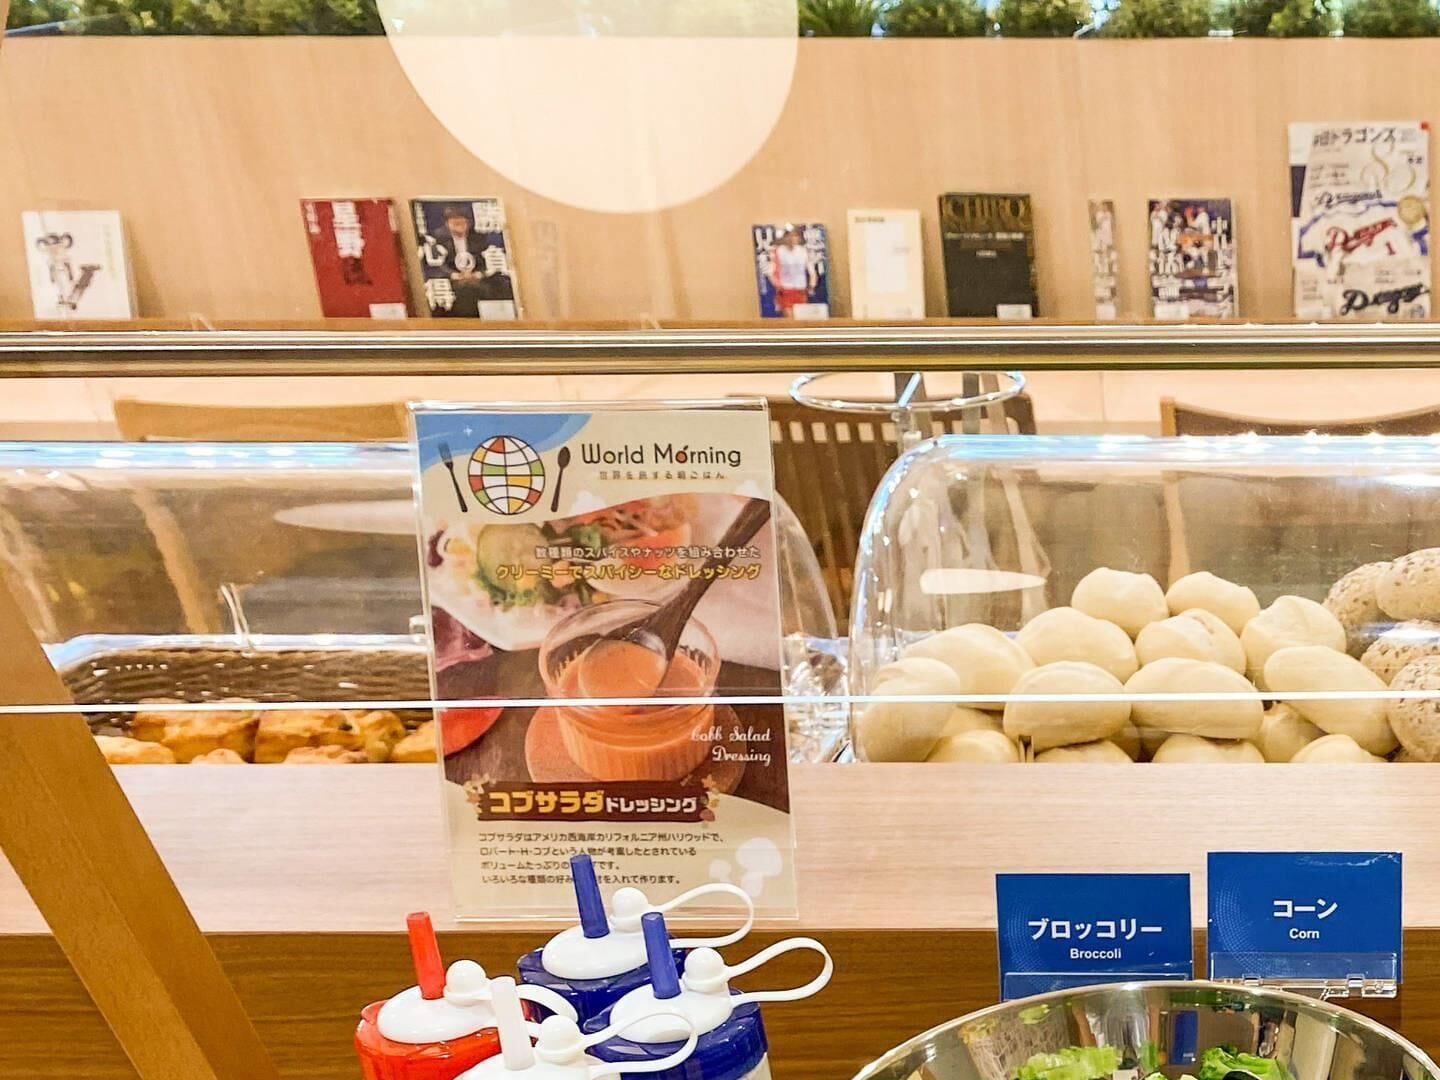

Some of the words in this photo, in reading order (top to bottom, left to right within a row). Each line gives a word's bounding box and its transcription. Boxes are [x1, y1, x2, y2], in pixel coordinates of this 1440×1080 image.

[581, 443, 644, 464] World
[496, 564, 761, 580] クリーミーでスパイシーなドレッシング
[729, 726, 771, 742] Salad
[712, 745, 771, 767] Dressing
[1273, 898, 1338, 919] コーン
[1028, 917, 1162, 940] ブロッコリー
[1289, 928, 1320, 939] Corn
[1069, 948, 1121, 959] Broccoli
